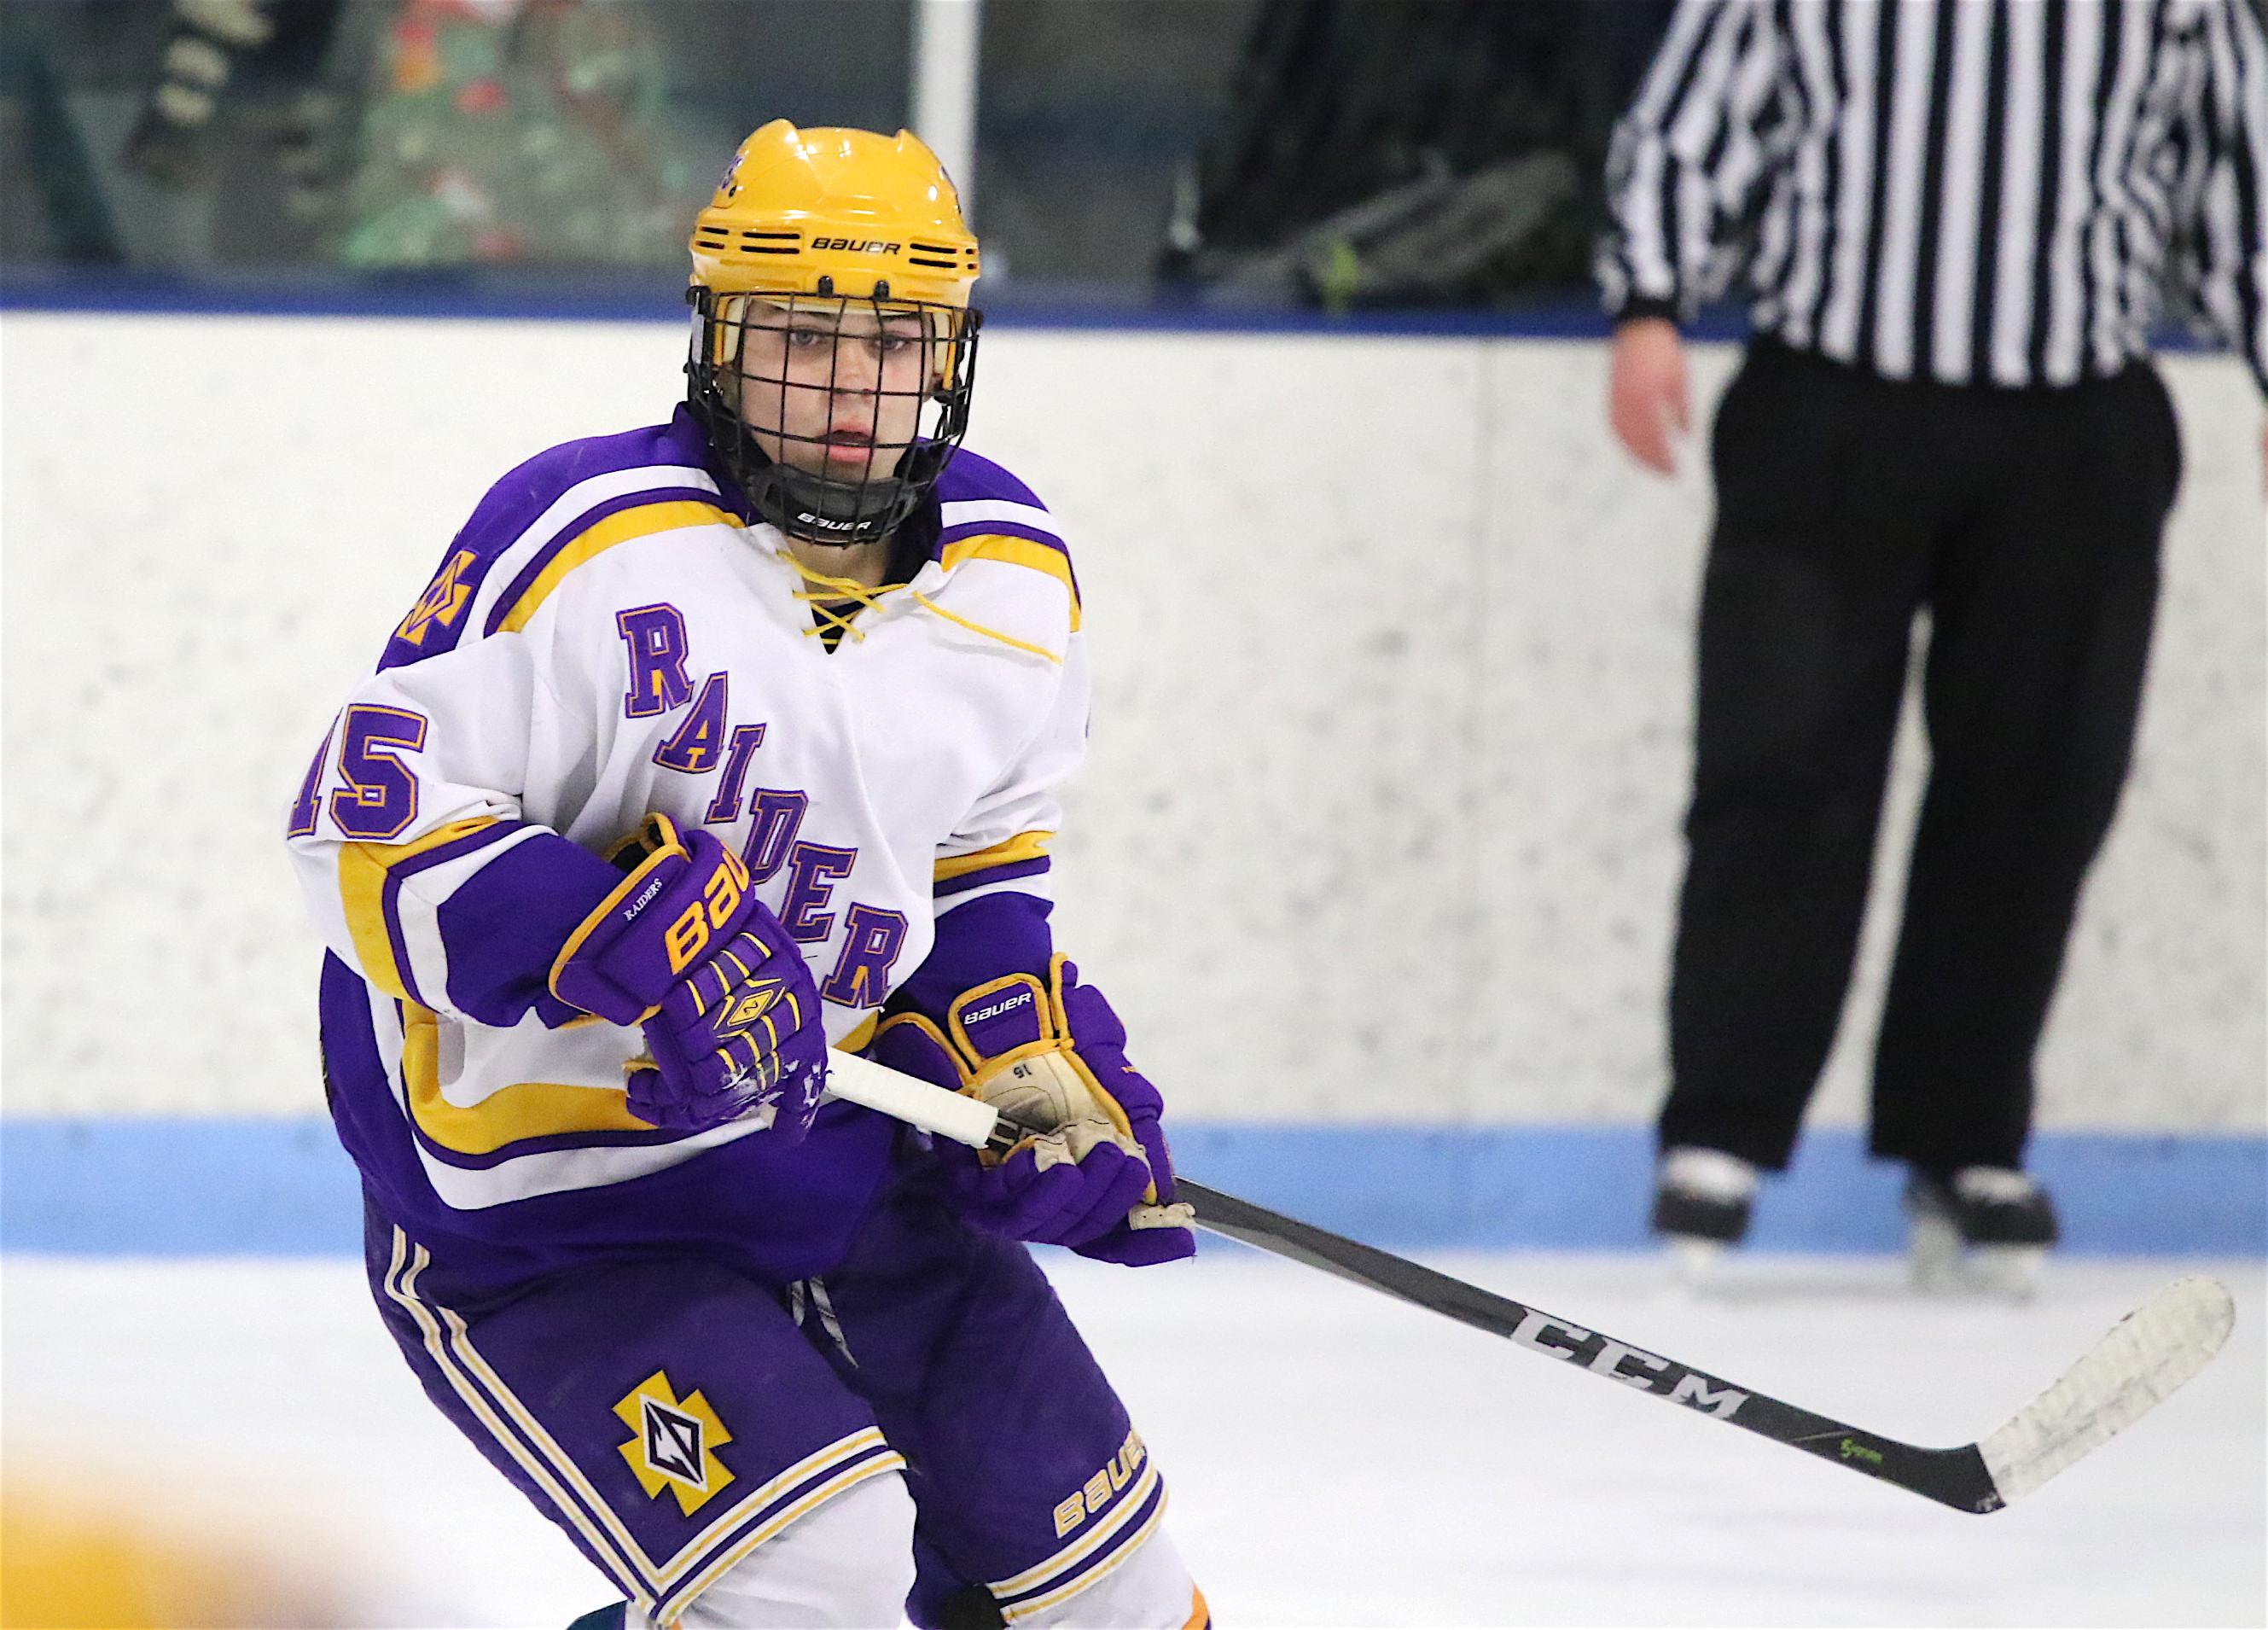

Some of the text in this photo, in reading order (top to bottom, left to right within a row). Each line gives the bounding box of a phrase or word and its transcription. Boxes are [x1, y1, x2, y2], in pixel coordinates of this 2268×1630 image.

[811, 237, 901, 255] BAUER
[797, 512, 872, 531] BAUER
[288, 702, 427, 840] 15
[616, 602, 909, 1010] RAIDER
[623, 878, 663, 921] RAIDERS
[665, 840, 750, 975] BAU
[964, 993, 1032, 1025] BAUER
[1510, 1308, 1750, 1421] CCM
[1053, 1430, 1146, 1539] BAUE
